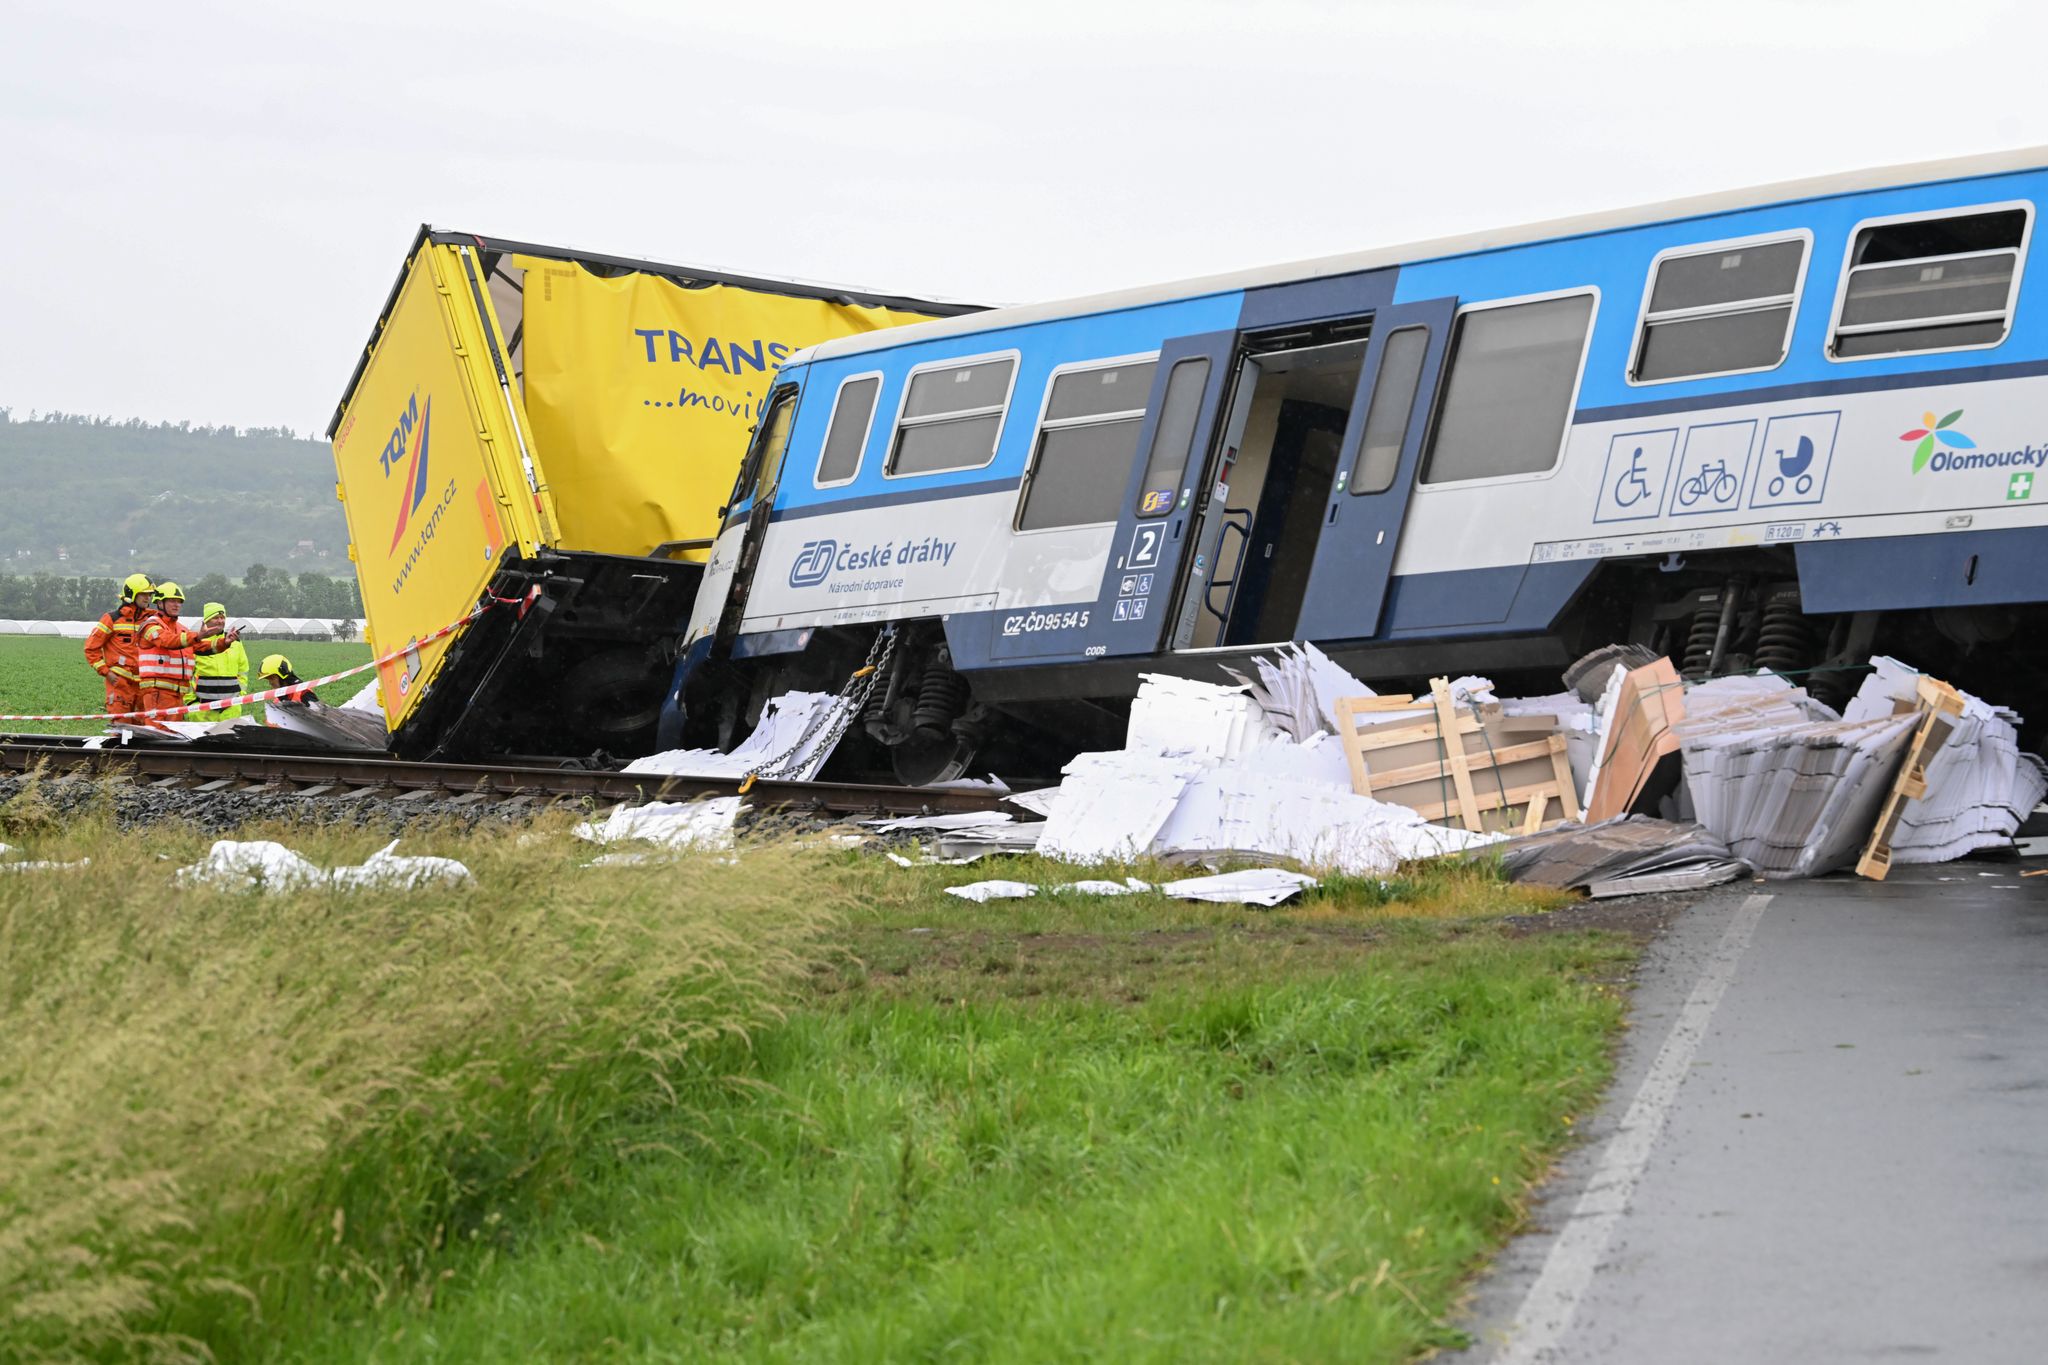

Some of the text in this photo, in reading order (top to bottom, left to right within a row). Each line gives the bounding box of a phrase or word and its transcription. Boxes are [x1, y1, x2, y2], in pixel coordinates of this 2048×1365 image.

[634, 328, 802, 375] TRANS
[379, 391, 419, 480] TQM
[1930, 443, 2048, 473] Olomoucký
[392, 477, 458, 595] www.tqm.cz
[1135, 530, 1156, 562] 2
[1767, 526, 1802, 538] R 120 m
[835, 537, 957, 572] České dráhy
[828, 578, 904, 594] Národní dopravce
[1079, 610, 1090, 628] 5
[1085, 645, 1107, 657] CODS
